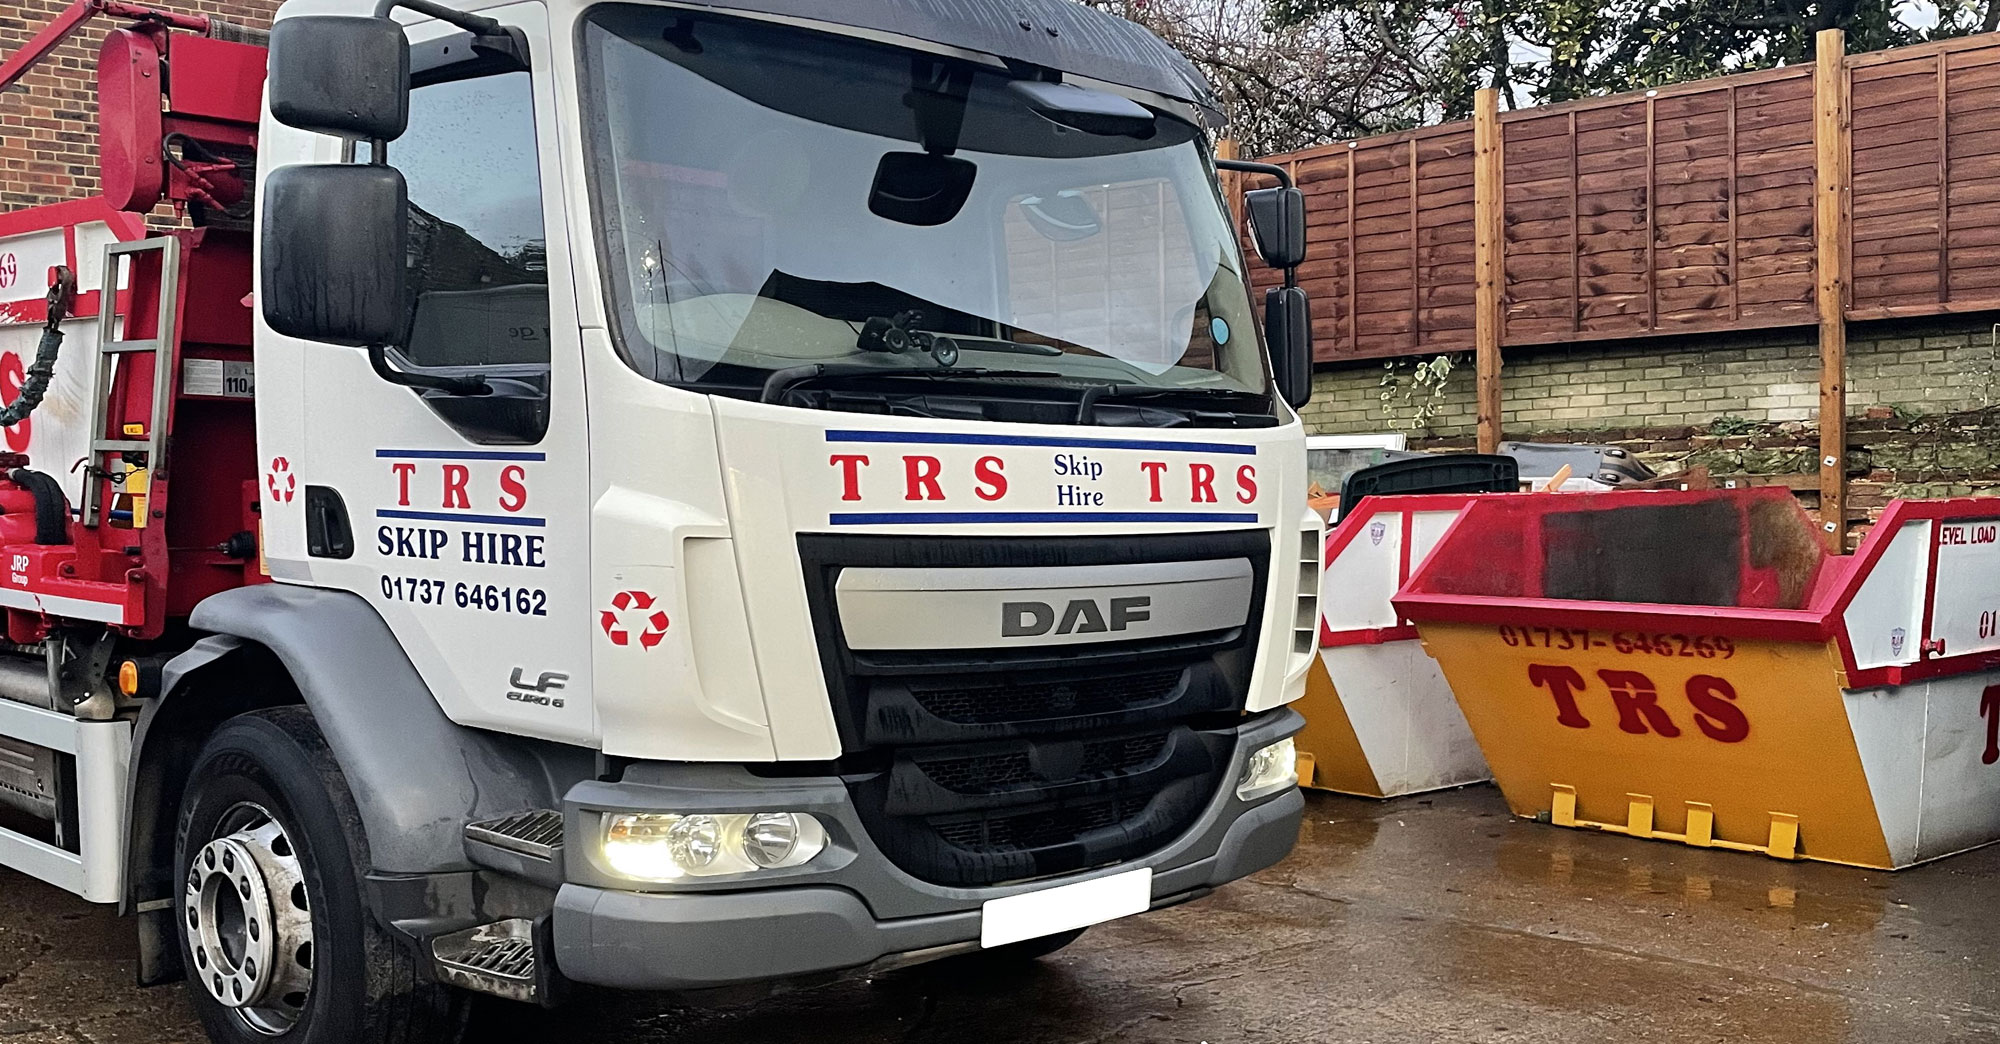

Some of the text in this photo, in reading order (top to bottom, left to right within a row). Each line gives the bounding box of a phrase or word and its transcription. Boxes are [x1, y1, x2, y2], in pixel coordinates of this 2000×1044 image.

[226, 377, 248, 393] 110
[1054, 454, 1103, 480] Skip
[1057, 485, 1104, 506] Hire
[378, 525, 546, 567] SKIP HIRE
[1940, 525, 1996, 545] EVEL LOAD
[11, 554, 29, 572] JRP
[381, 574, 547, 616] 01737 646162
[1002, 595, 1151, 638] DAF
[510, 667, 569, 693] LF
[1528, 663, 1750, 743] TRS
